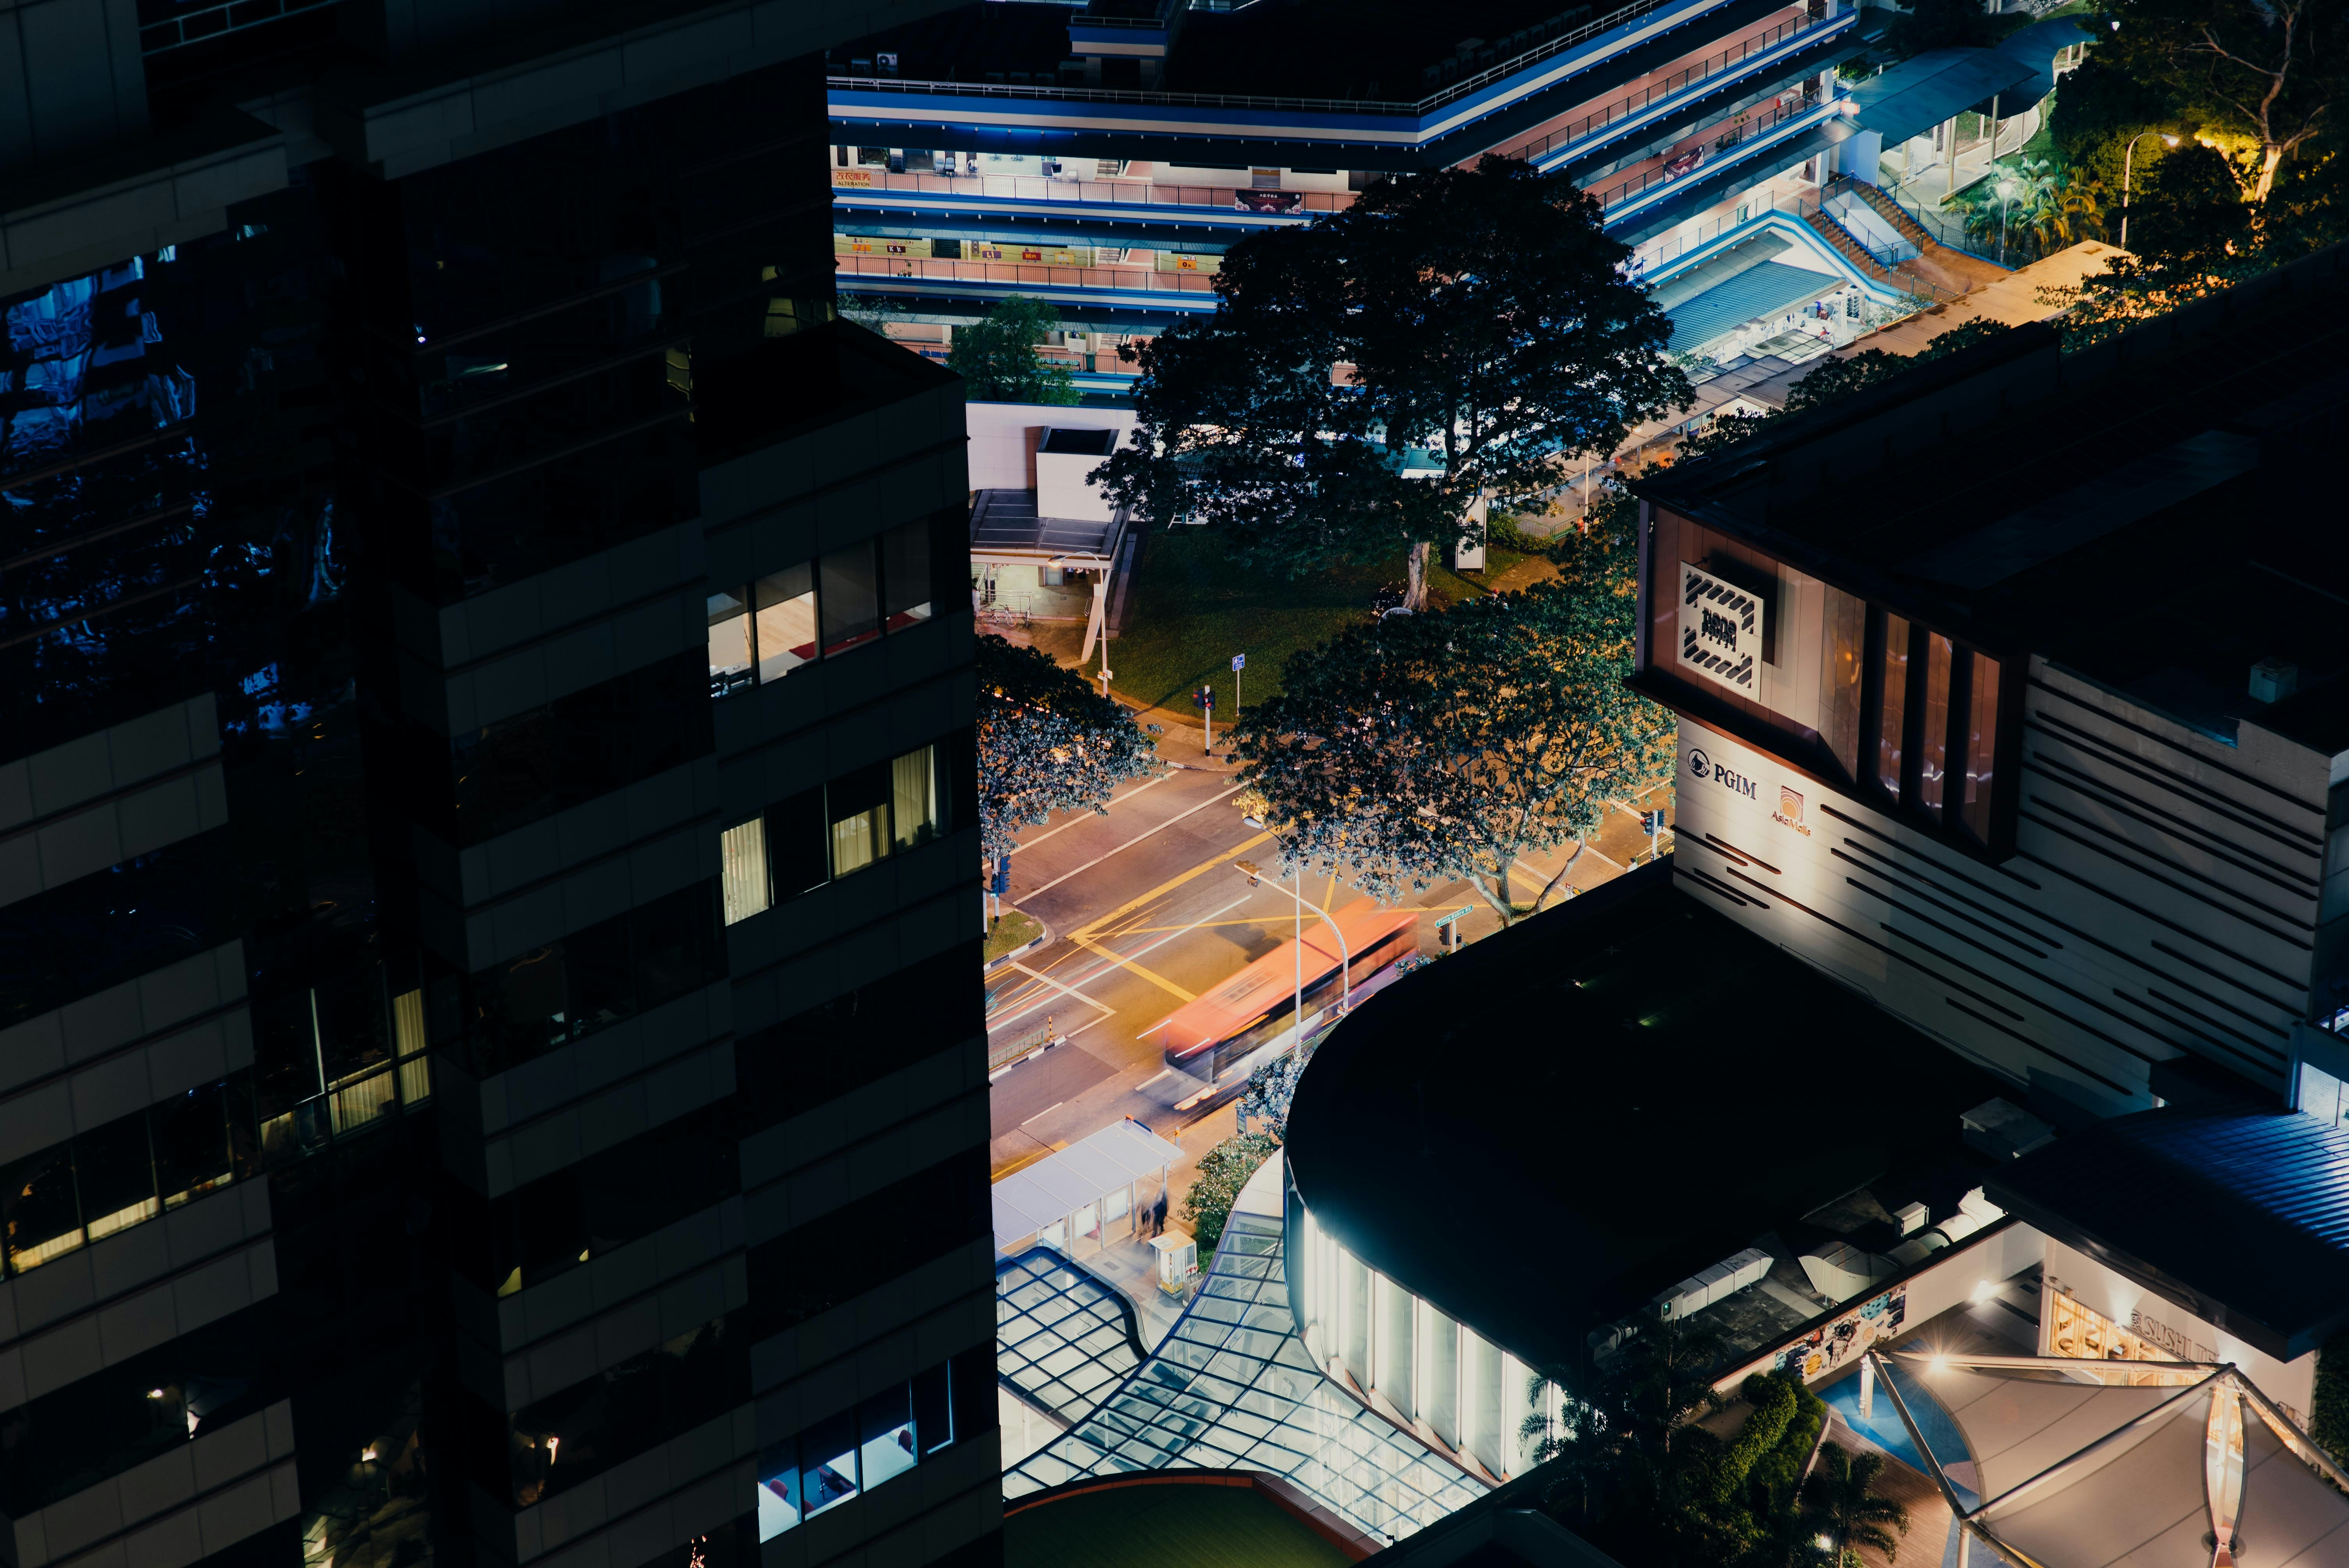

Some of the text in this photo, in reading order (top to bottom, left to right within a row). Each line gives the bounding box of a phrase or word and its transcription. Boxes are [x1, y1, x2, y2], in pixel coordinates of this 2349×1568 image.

[836, 172, 870, 181] 改衣服务
[1714, 763, 1756, 800] PGIM
[1771, 811, 1811, 837] AsiaMalls
[1438, 917, 1451, 925] Tiong
[2144, 1316, 2192, 1360] SUSHI
